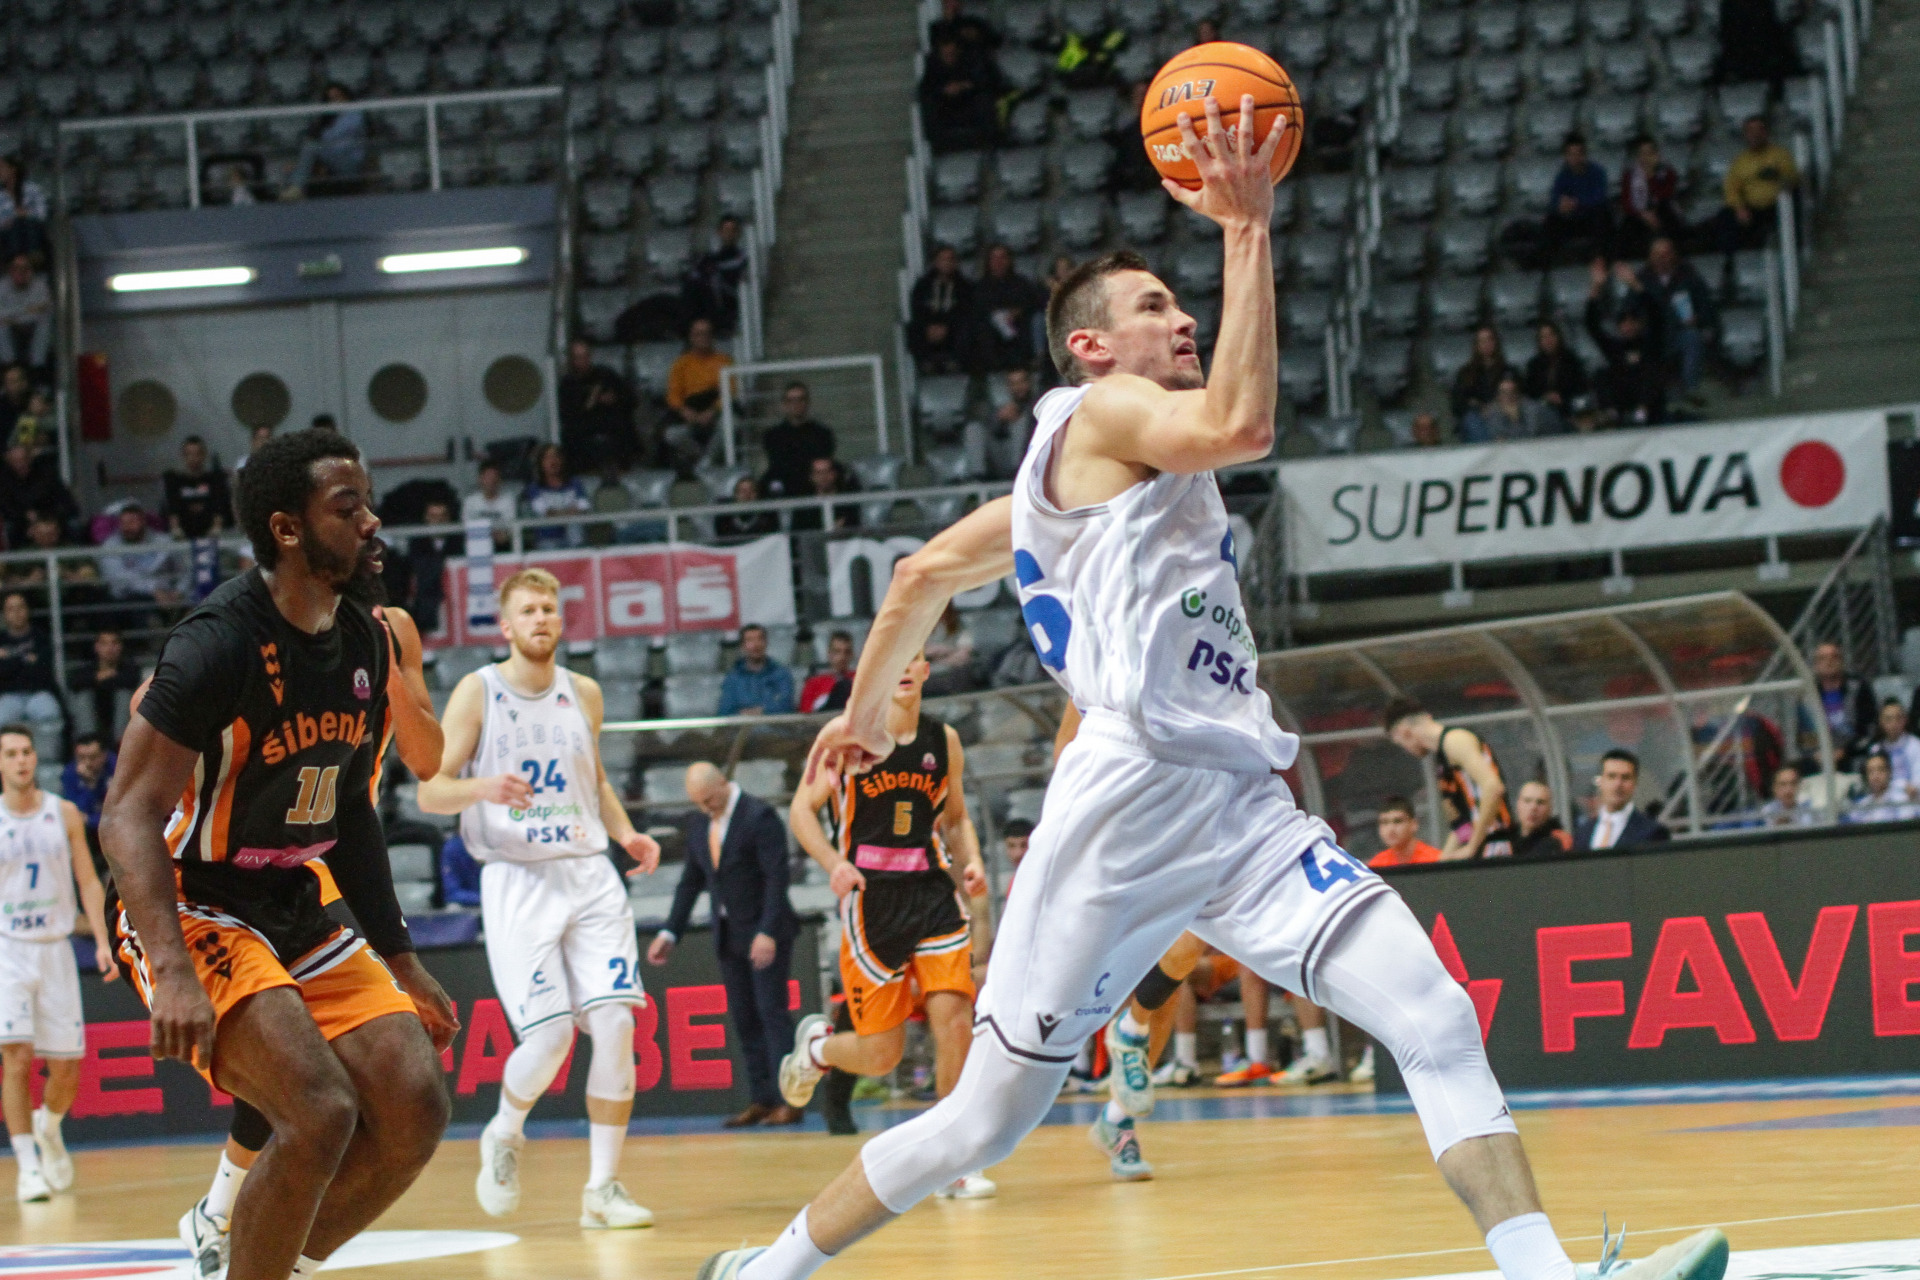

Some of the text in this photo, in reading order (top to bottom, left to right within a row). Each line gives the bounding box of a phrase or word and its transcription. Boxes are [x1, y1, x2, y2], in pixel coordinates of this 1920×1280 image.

[1159, 79, 1216, 111] EVO
[1328, 452, 1760, 545] SUPERNOVA
[1186, 638, 1252, 695] PSK
[521, 758, 567, 794] 24
[285, 765, 340, 825] 10
[526, 824, 571, 843] PSK
[893, 801, 913, 835] 5
[26, 862, 39, 890] 7
[608, 956, 643, 991] 2
